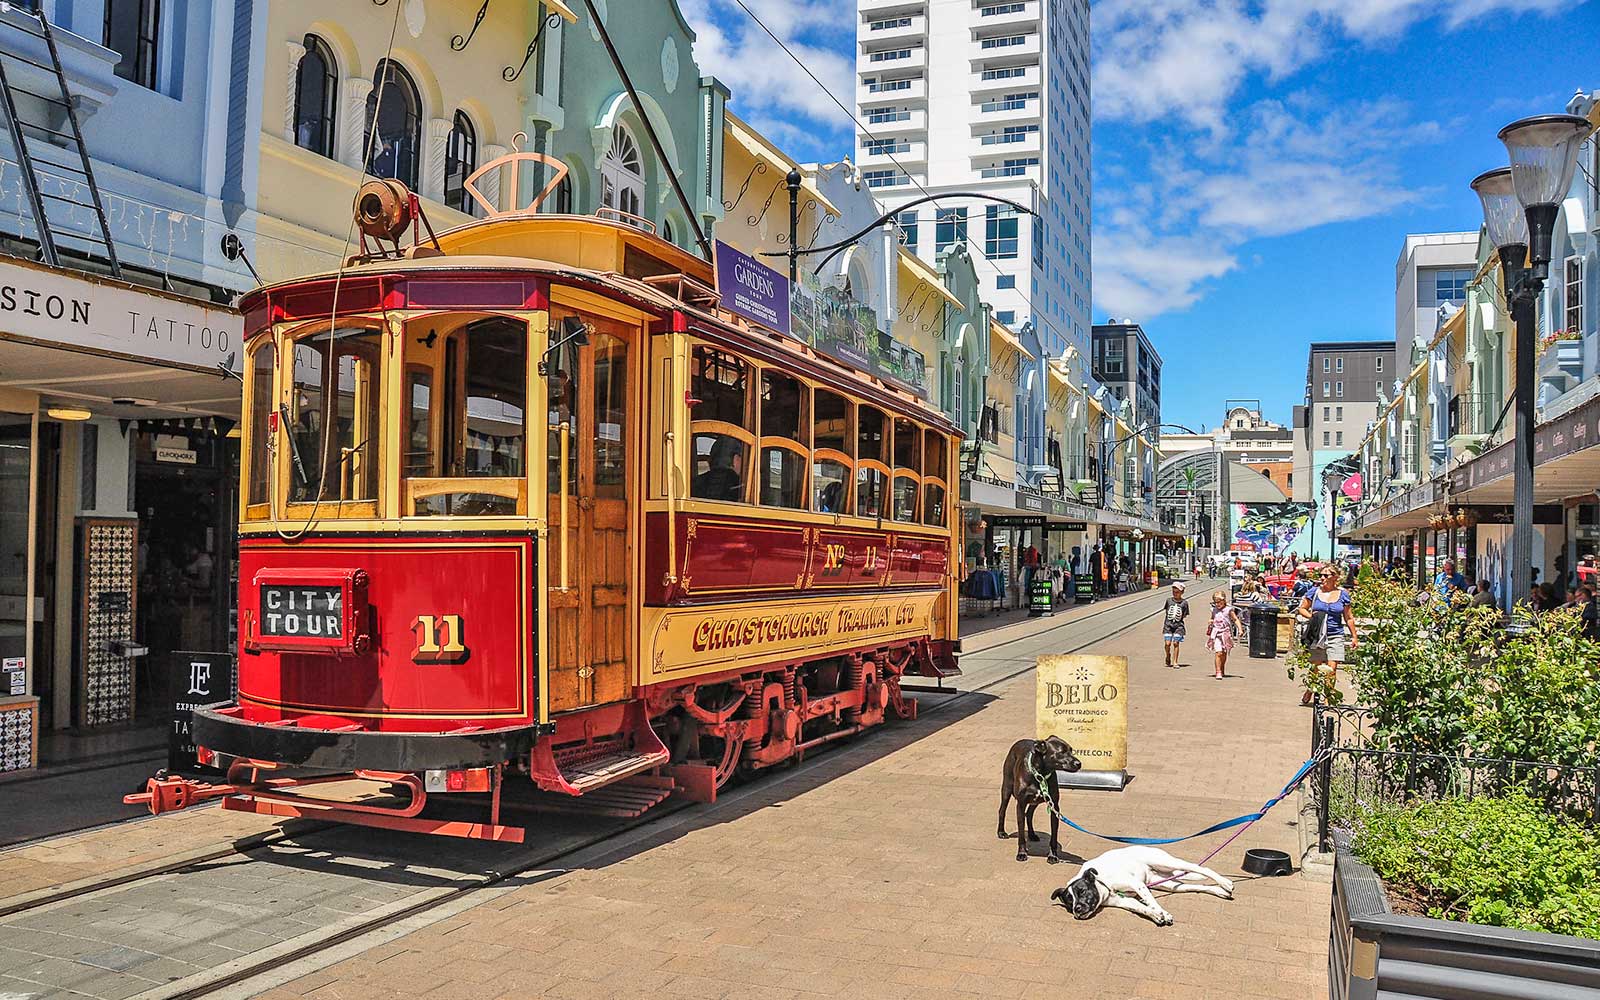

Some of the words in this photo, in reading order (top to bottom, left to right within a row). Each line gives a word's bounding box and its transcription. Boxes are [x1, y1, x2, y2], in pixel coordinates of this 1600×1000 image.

[735, 264, 774, 298] GARDENS
[735, 293, 750, 305] GUIDED
[750, 301, 776, 317] CHRISTCHURCH
[749, 290, 762, 300] TOUR
[735, 300, 752, 312] BOTANIC
[752, 307, 768, 320] GARDENS
[768, 315, 778, 325] TOUR
[128, 311, 230, 353] TATTOO
[863, 545, 877, 568] 11
[1033, 595, 1050, 604] OPEN
[1078, 585, 1092, 593] OPEN
[266, 590, 342, 612] CITY
[266, 613, 342, 635] TOUR
[692, 611, 832, 652] CHRISTCHURCH
[837, 605, 892, 633] TRAMWAY
[895, 603, 916, 626] LTD
[411, 615, 467, 658] 11
[1045, 681, 1118, 709] BELO
[1071, 749, 1112, 757] OFFEE.CO.NZ
